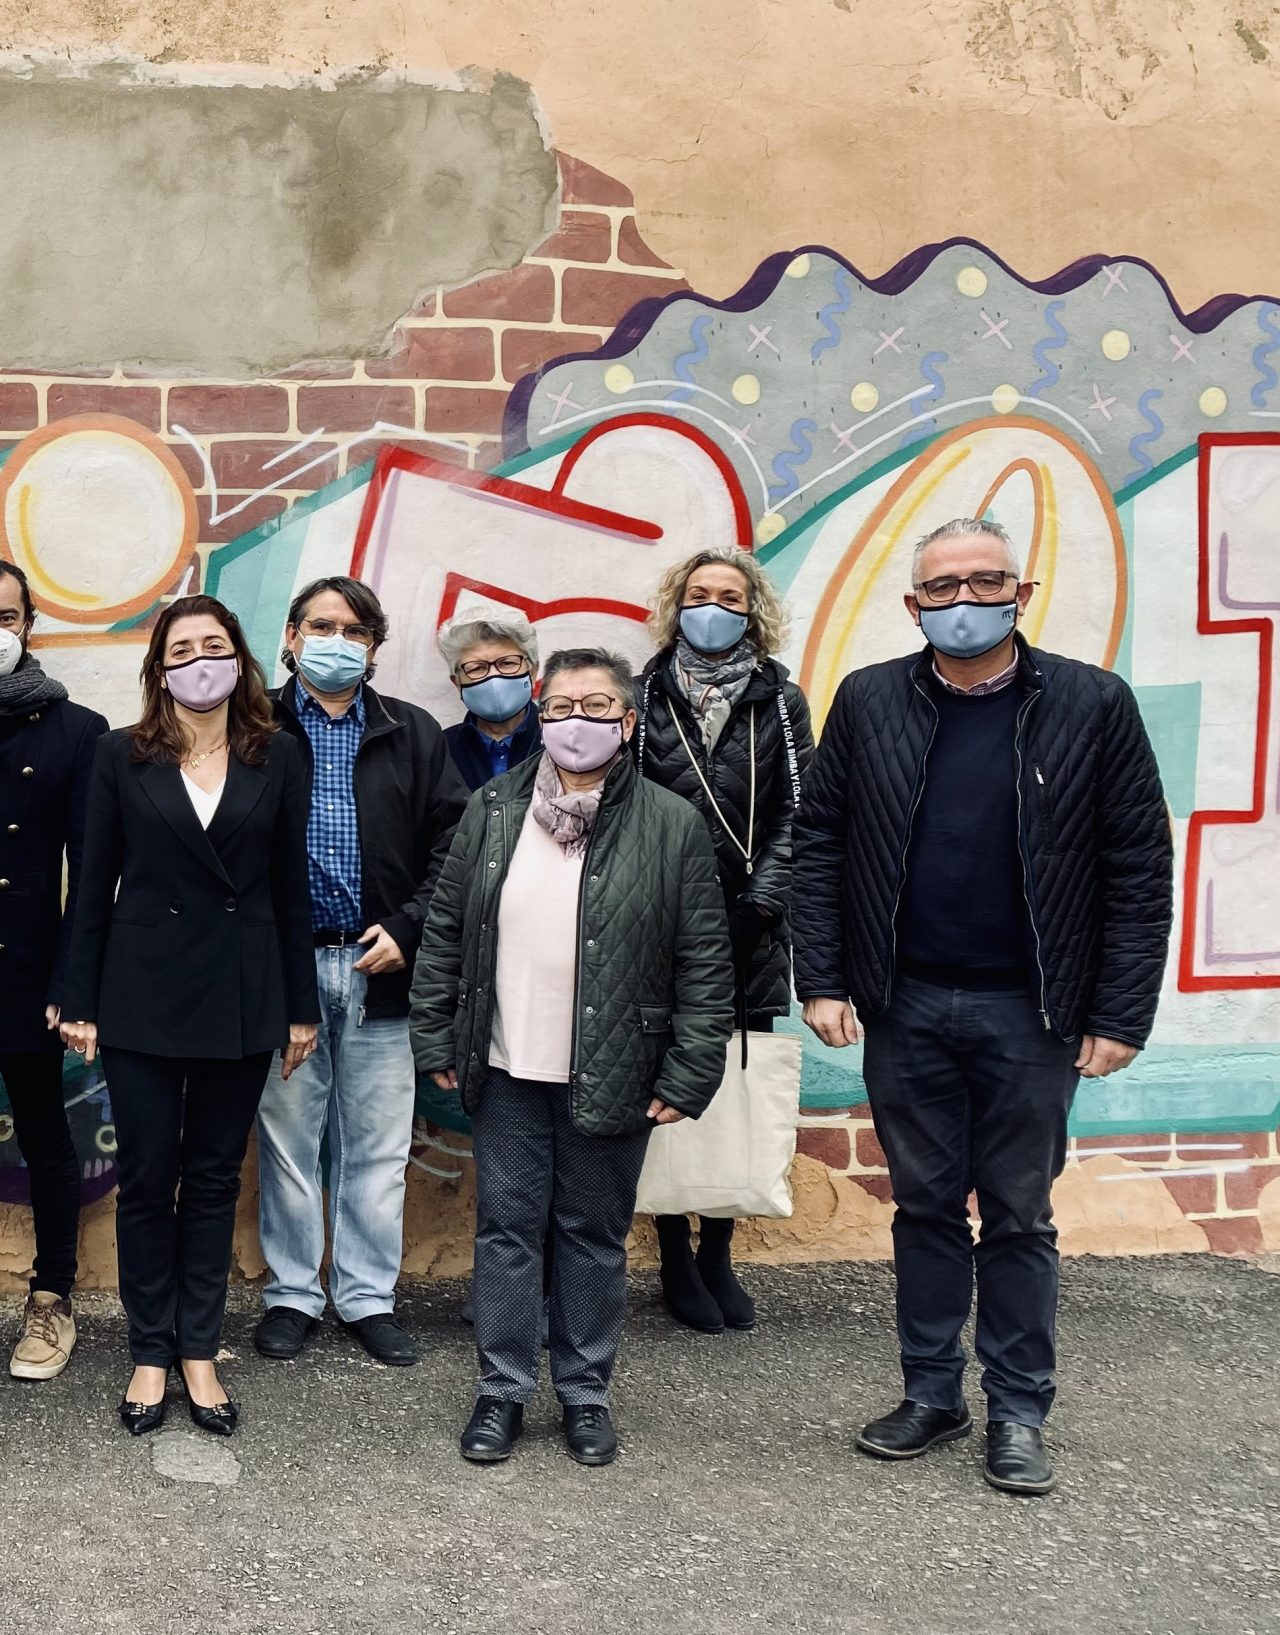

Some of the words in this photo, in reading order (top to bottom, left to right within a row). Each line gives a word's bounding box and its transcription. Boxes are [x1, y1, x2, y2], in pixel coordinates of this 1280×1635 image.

[777, 694, 789, 720] BIMBA
[783, 727, 794, 748] LOLA
[787, 748, 799, 775] BIMBA
[792, 781, 801, 802] LOLA
